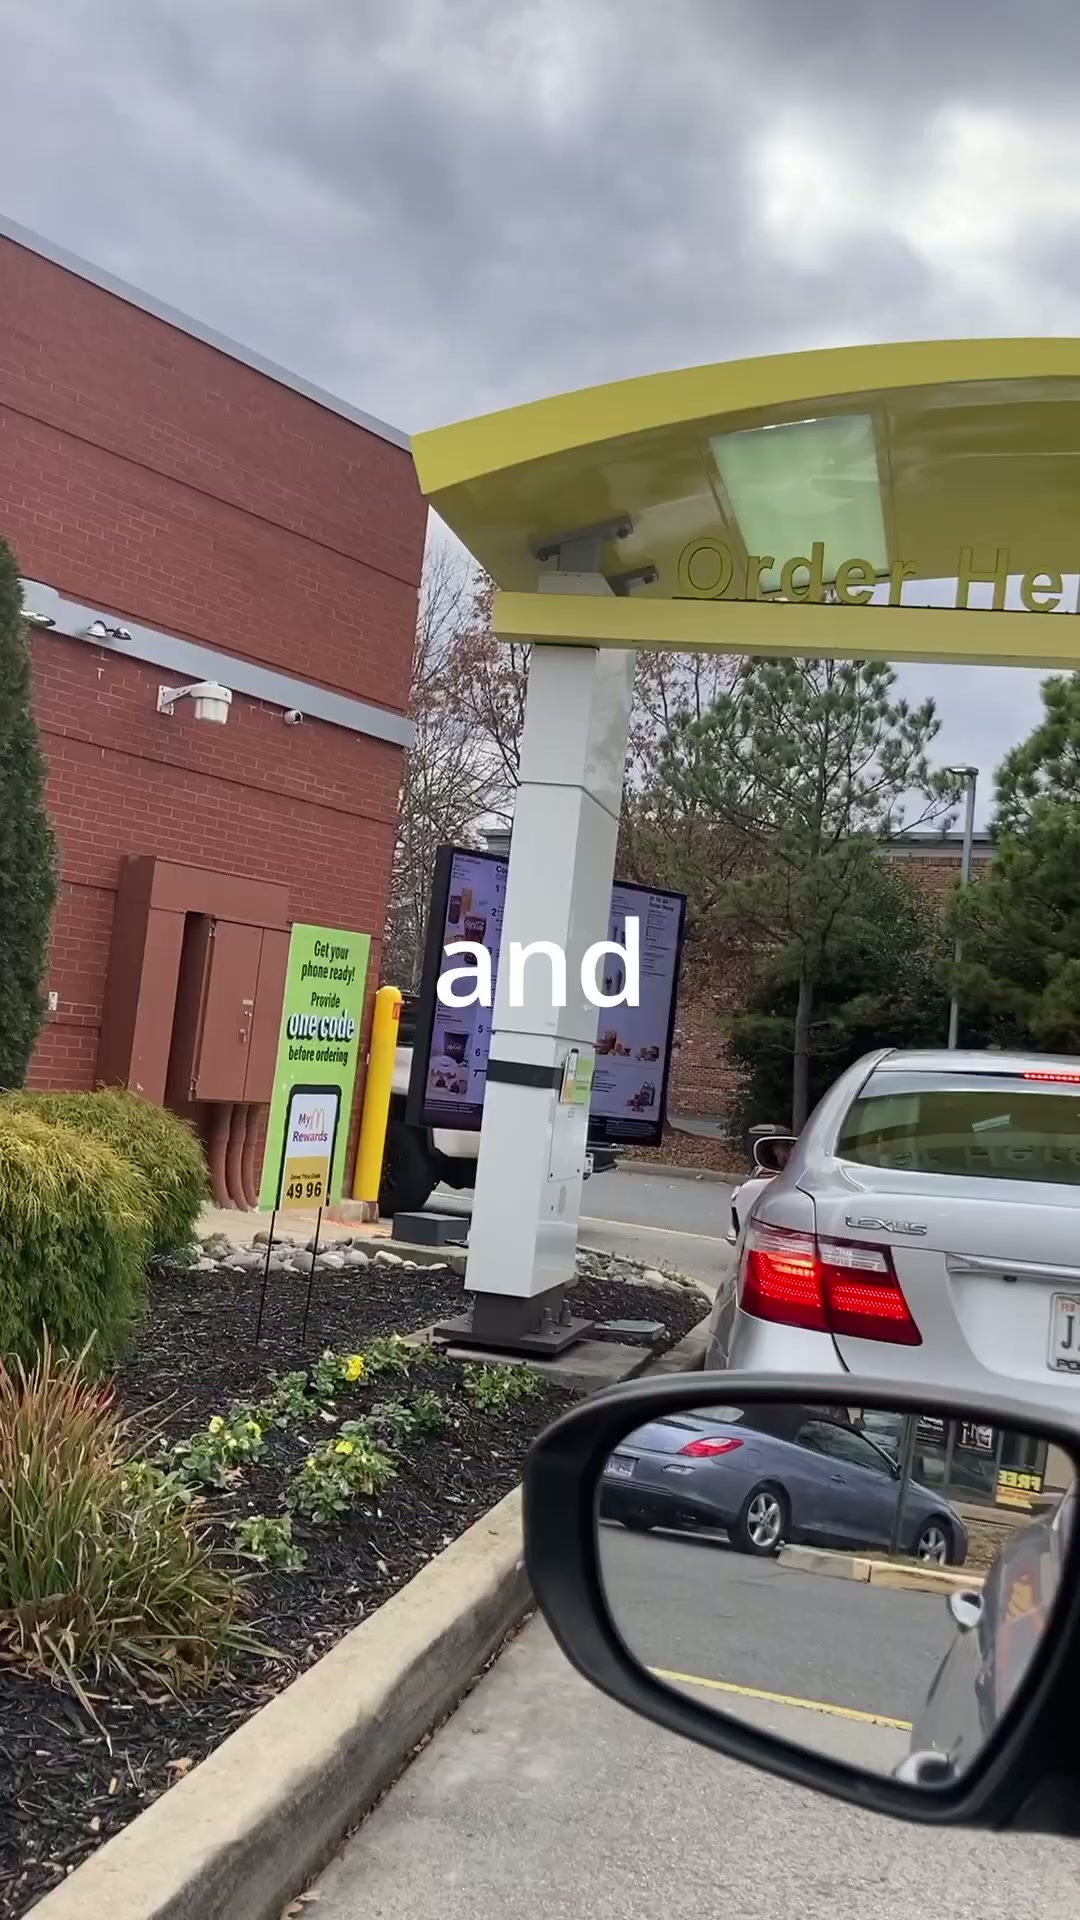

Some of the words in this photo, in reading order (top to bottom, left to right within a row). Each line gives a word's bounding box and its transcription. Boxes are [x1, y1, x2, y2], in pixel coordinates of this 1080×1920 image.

[677, 537, 919, 606] Order
[955, 546, 1080, 613] He
[491, 908, 497, 917] 2
[314, 940, 330, 957] Get
[330, 945, 349, 963] your
[301, 960, 328, 981] phone
[329, 966, 356, 986] ready!
[310, 991, 341, 1009] Provide
[287, 1012, 318, 1040] one
[318, 1009, 355, 1043] code
[288, 1045, 315, 1061] before
[315, 1046, 349, 1066] ordering
[298, 1113, 312, 1128] My
[292, 1131, 328, 1143] Rewards
[286, 1183, 303, 1199] 49
[306, 1181, 322, 1198] 96
[845, 1215, 927, 1236] LEXUS
[1056, 1358, 1080, 1370] PO
